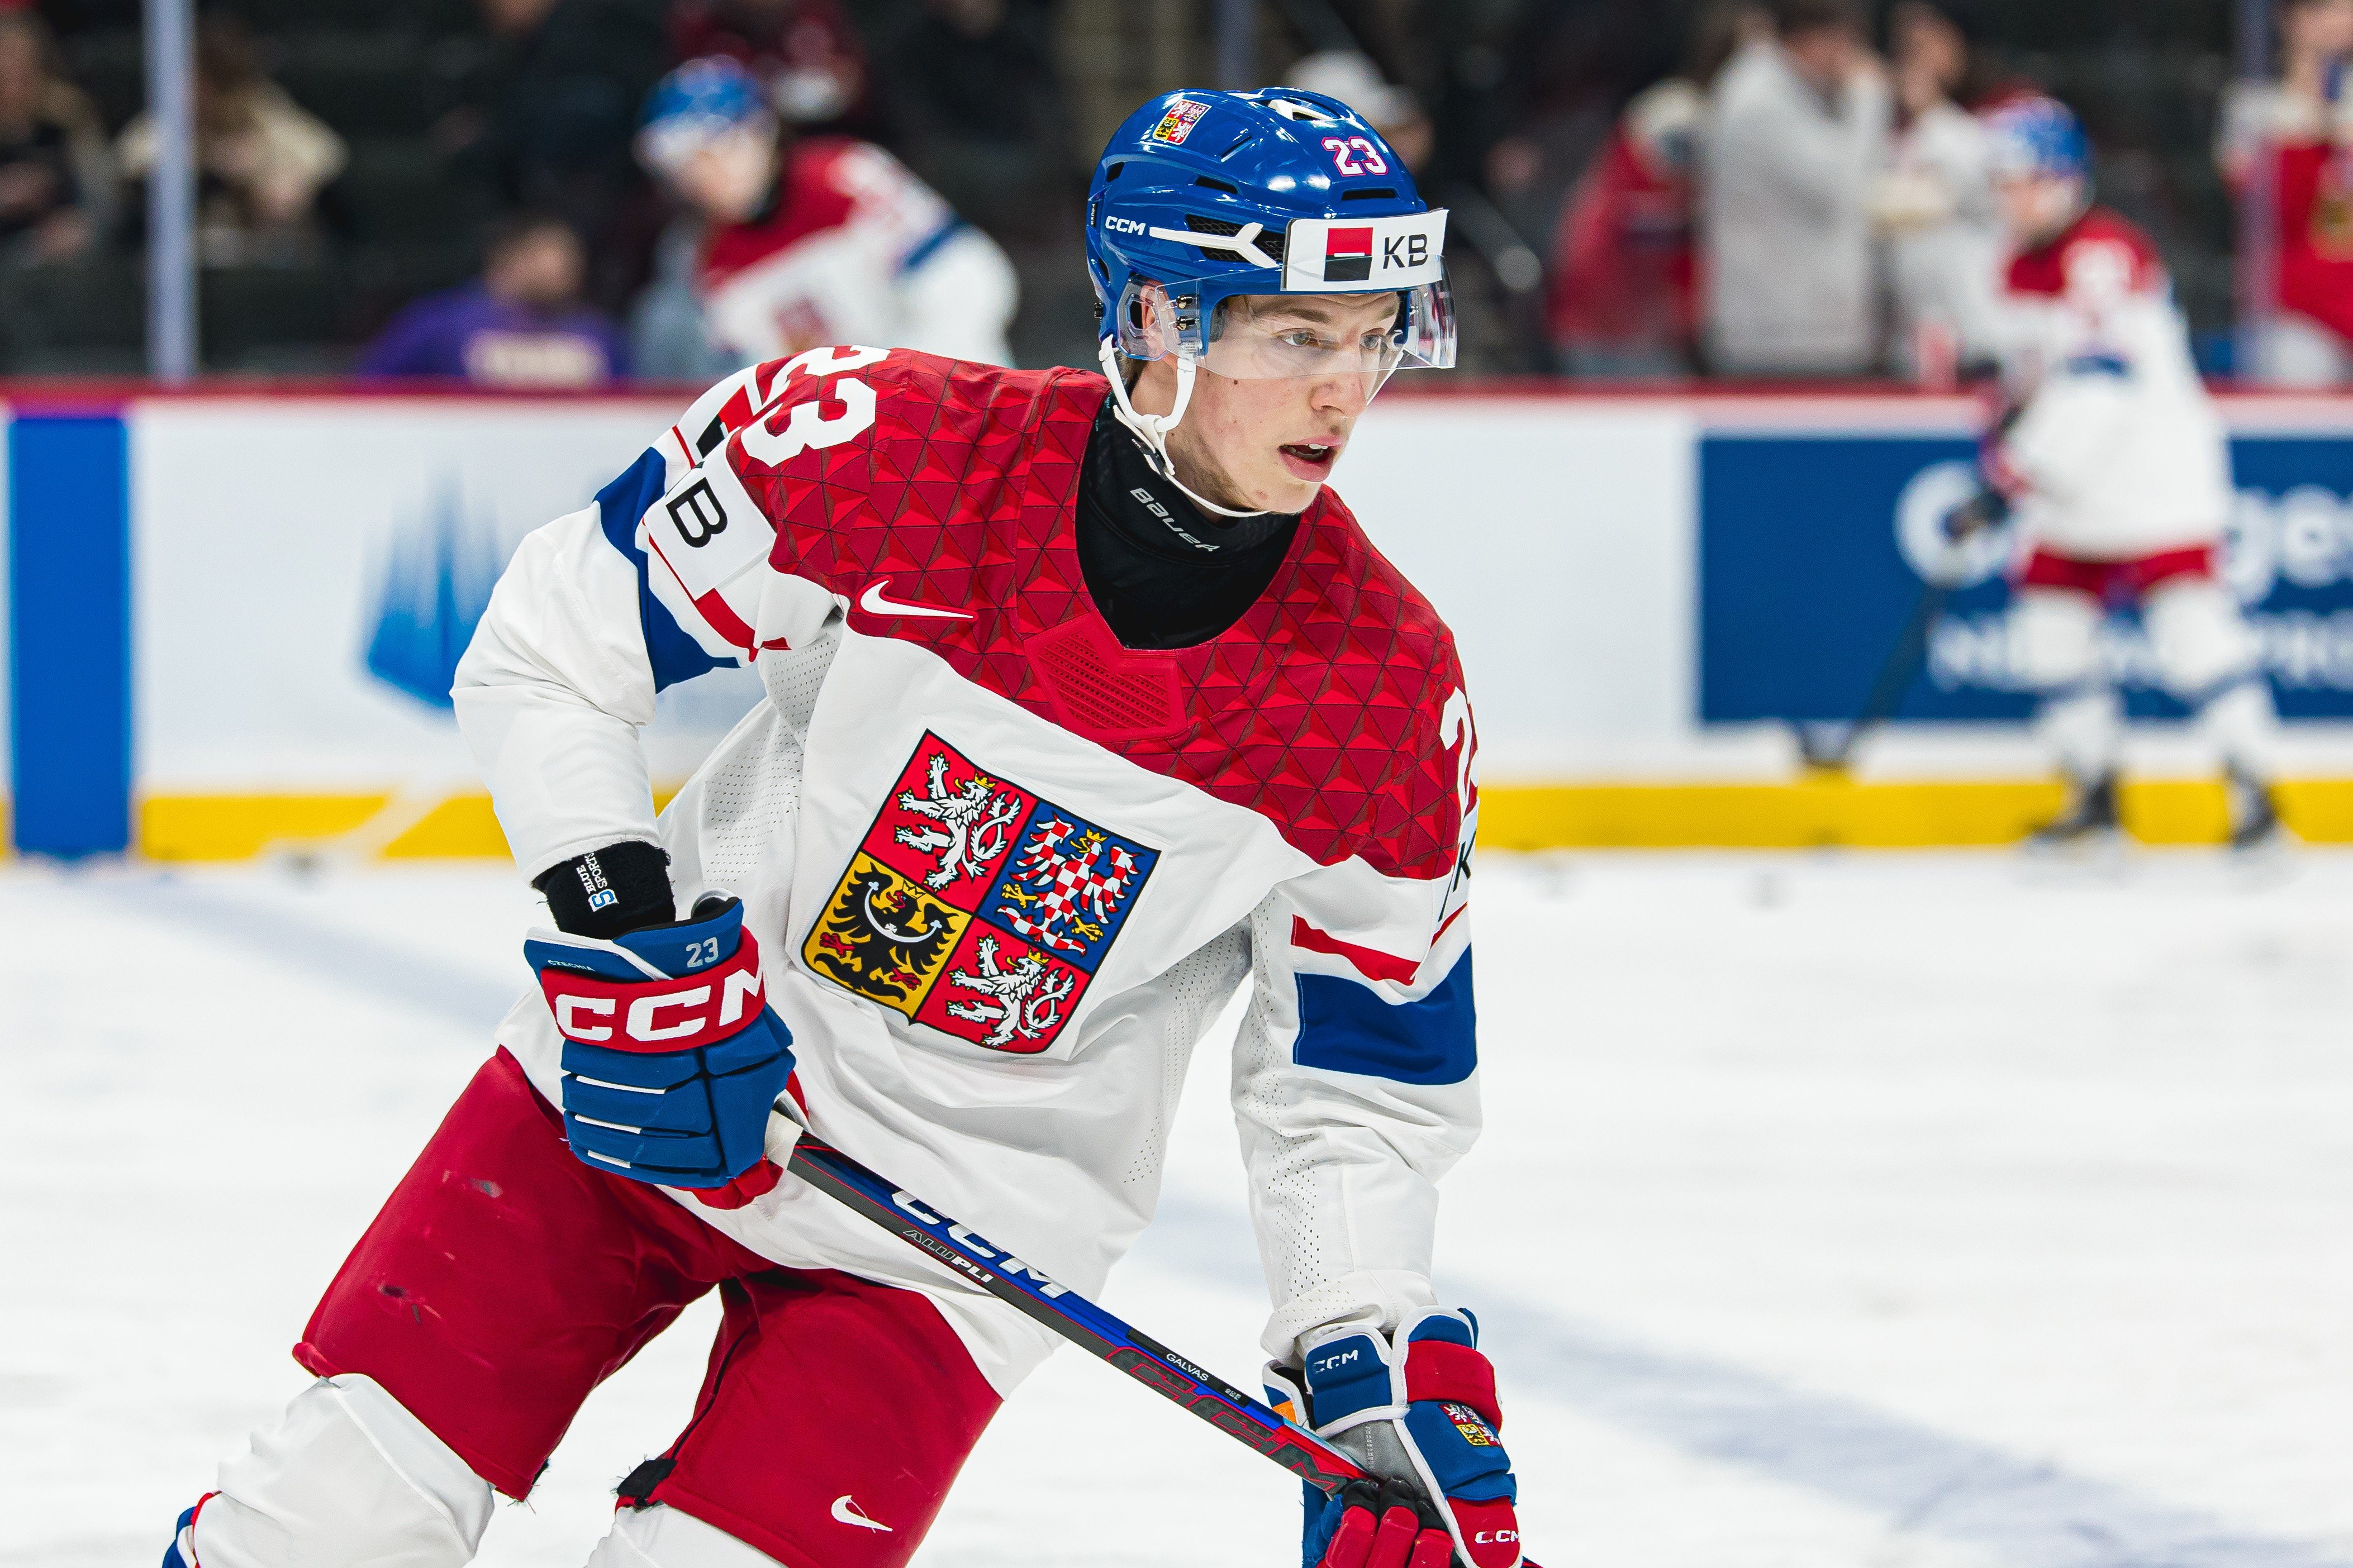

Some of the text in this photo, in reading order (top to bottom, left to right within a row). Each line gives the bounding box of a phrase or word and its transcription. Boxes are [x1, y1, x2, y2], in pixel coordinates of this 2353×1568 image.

[1321, 136, 1389, 177] 23
[1105, 216, 1146, 236] CCM
[1382, 233, 1427, 269] KB
[740, 344, 891, 468] 23
[1130, 488, 1220, 552] BAUER
[576, 865, 597, 894] BLUE
[584, 852, 608, 889] SPORTS
[547, 960, 596, 971] CZECHIA
[686, 936, 719, 968] 23
[555, 968, 768, 1042] CCM
[892, 1190, 1071, 1299] CCM
[902, 1228, 997, 1284] ALUPLI
[1166, 1353, 1209, 1381] GALVAS
